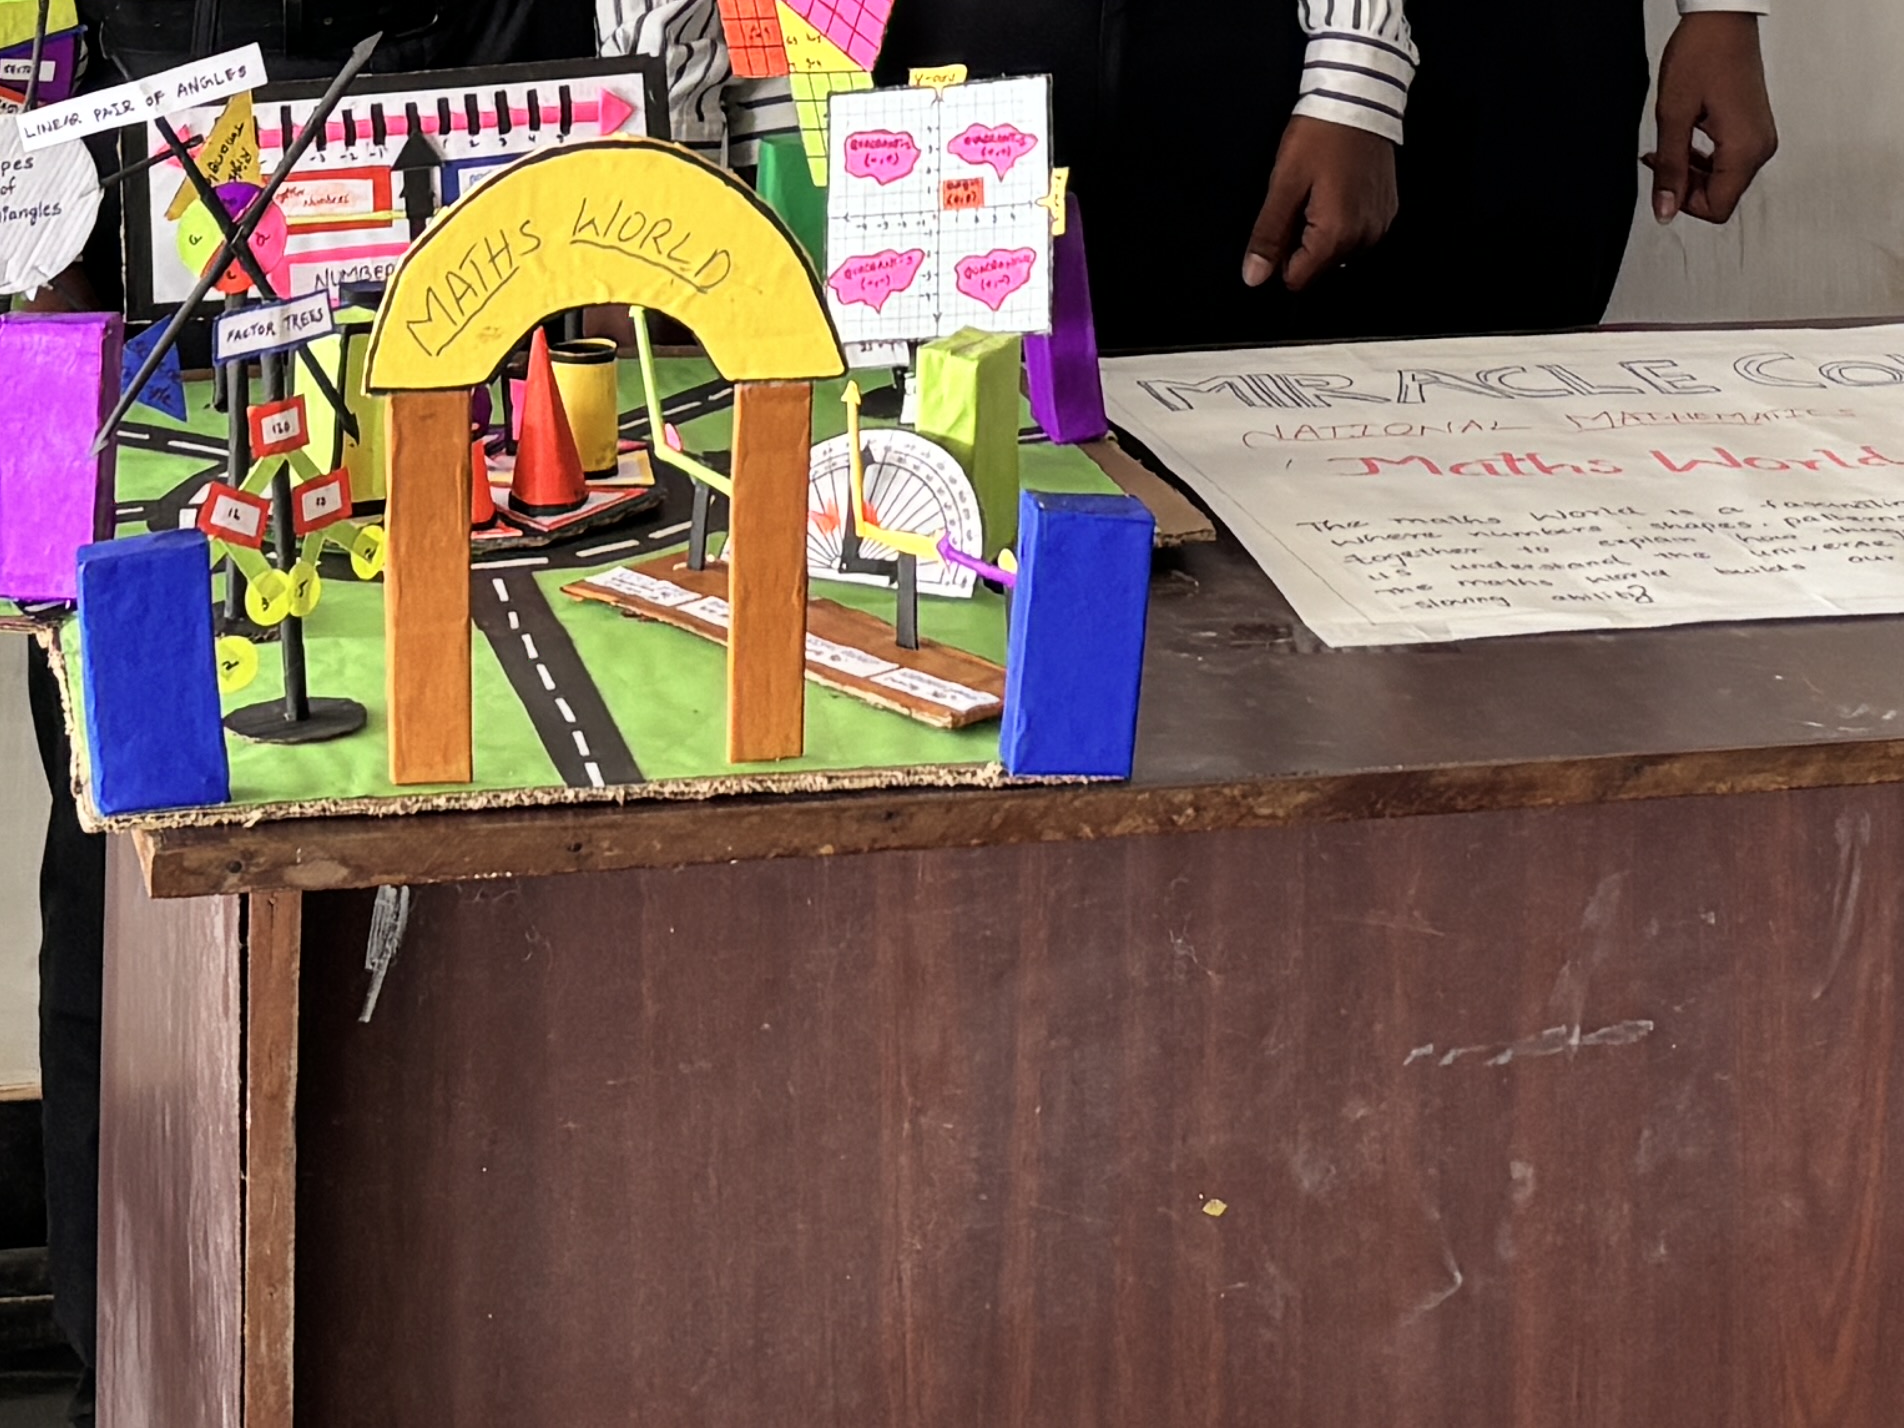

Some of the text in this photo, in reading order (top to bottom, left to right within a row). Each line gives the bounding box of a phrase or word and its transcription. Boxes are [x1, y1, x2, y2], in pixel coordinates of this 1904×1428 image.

[146, 90, 165, 107] OF
[177, 65, 248, 98] ANGLES
[0, 180, 17, 197] of
[406, 197, 732, 357] MATHS WORLD
[227, 307, 324, 343] FACTOR TREES
[1137, 357, 1722, 411] MIRACLE
[1242, 419, 1532, 449] NATIONAL
[1327, 451, 1624, 477] Maths
[1296, 519, 1370, 533] The
[1392, 514, 1503, 526] maths
[1718, 505, 1744, 515] a
